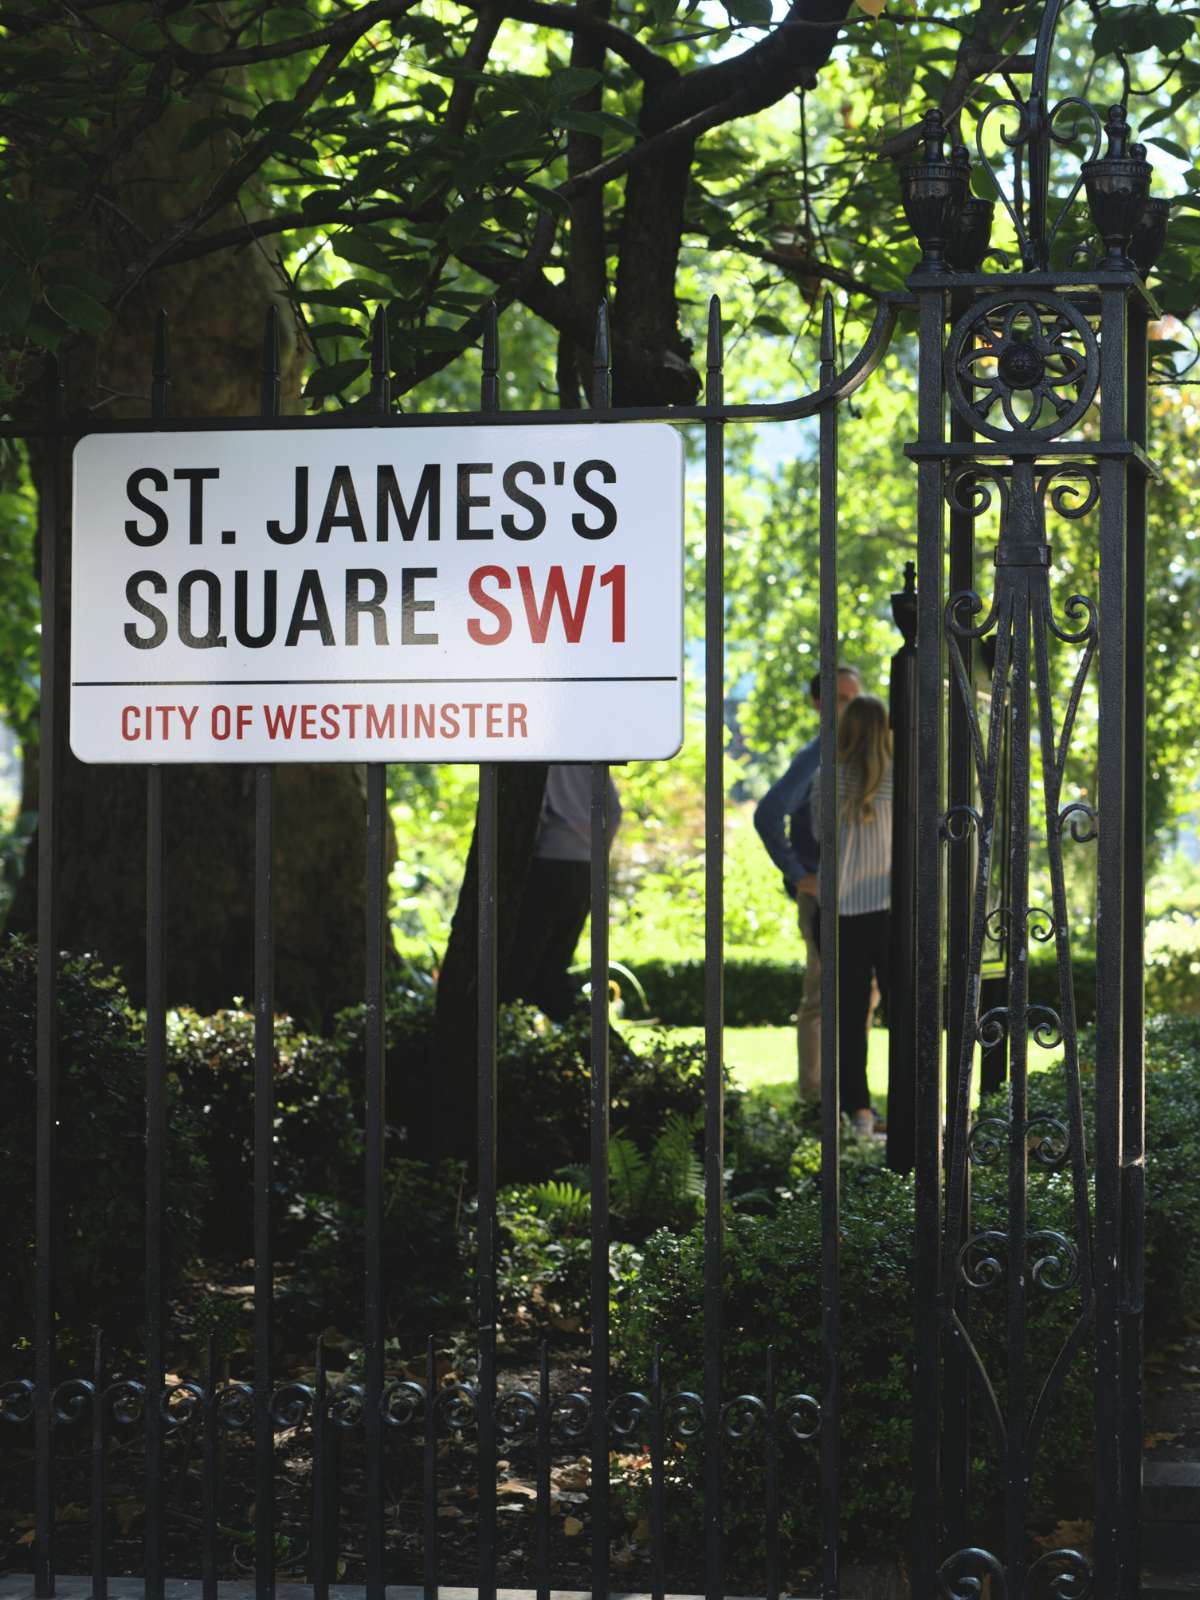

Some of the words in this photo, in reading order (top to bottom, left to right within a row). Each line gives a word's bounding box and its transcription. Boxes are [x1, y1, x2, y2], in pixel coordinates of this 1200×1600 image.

[125, 467, 236, 547] ST.
[266, 460, 618, 546] JAMES'S
[124, 568, 439, 649] SQUARE
[467, 564, 626, 645] SW1
[121, 705, 199, 741] CITY
[211, 704, 254, 741] OF
[263, 703, 528, 740] WESTMINSTER
